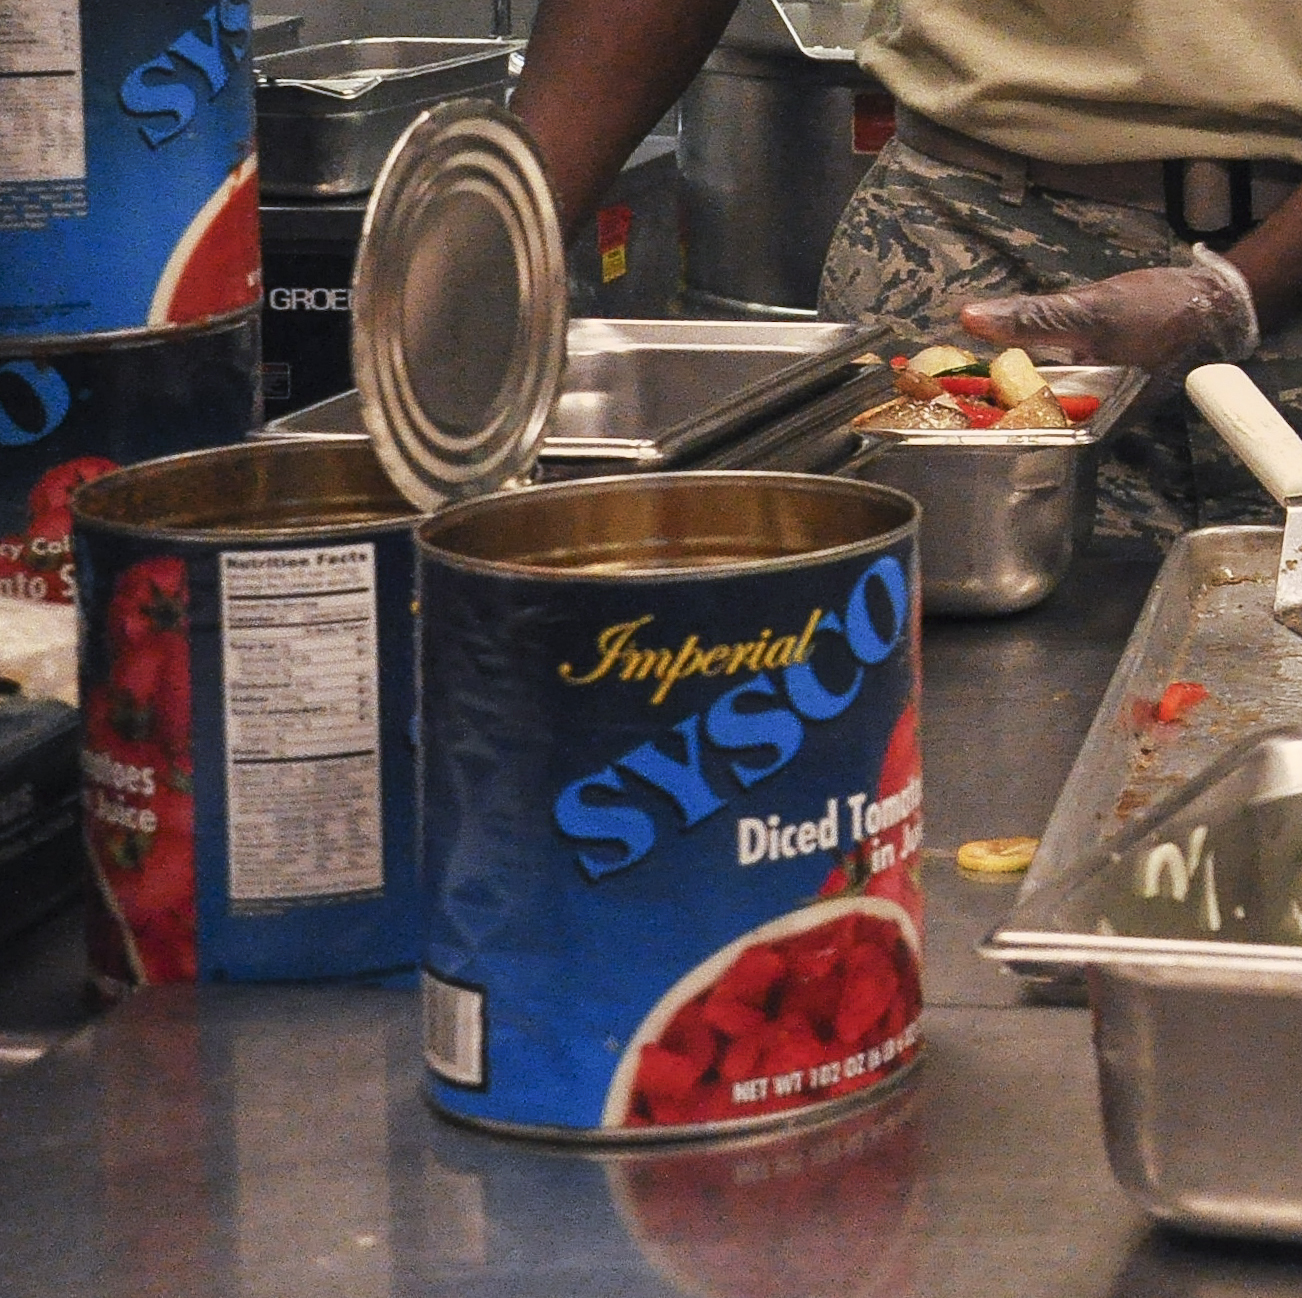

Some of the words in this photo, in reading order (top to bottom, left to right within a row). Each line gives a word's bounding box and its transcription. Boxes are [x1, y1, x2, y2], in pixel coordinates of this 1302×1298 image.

[227, 558, 310, 569] Nutrition
[317, 553, 368, 565] Facts
[558, 607, 822, 705] Imperial
[554, 555, 908, 879] SYSCO
[738, 797, 839, 867] Diced
[871, 837, 896, 873] in
[731, 1077, 769, 1104] NET
[772, 1070, 803, 1097] WT
